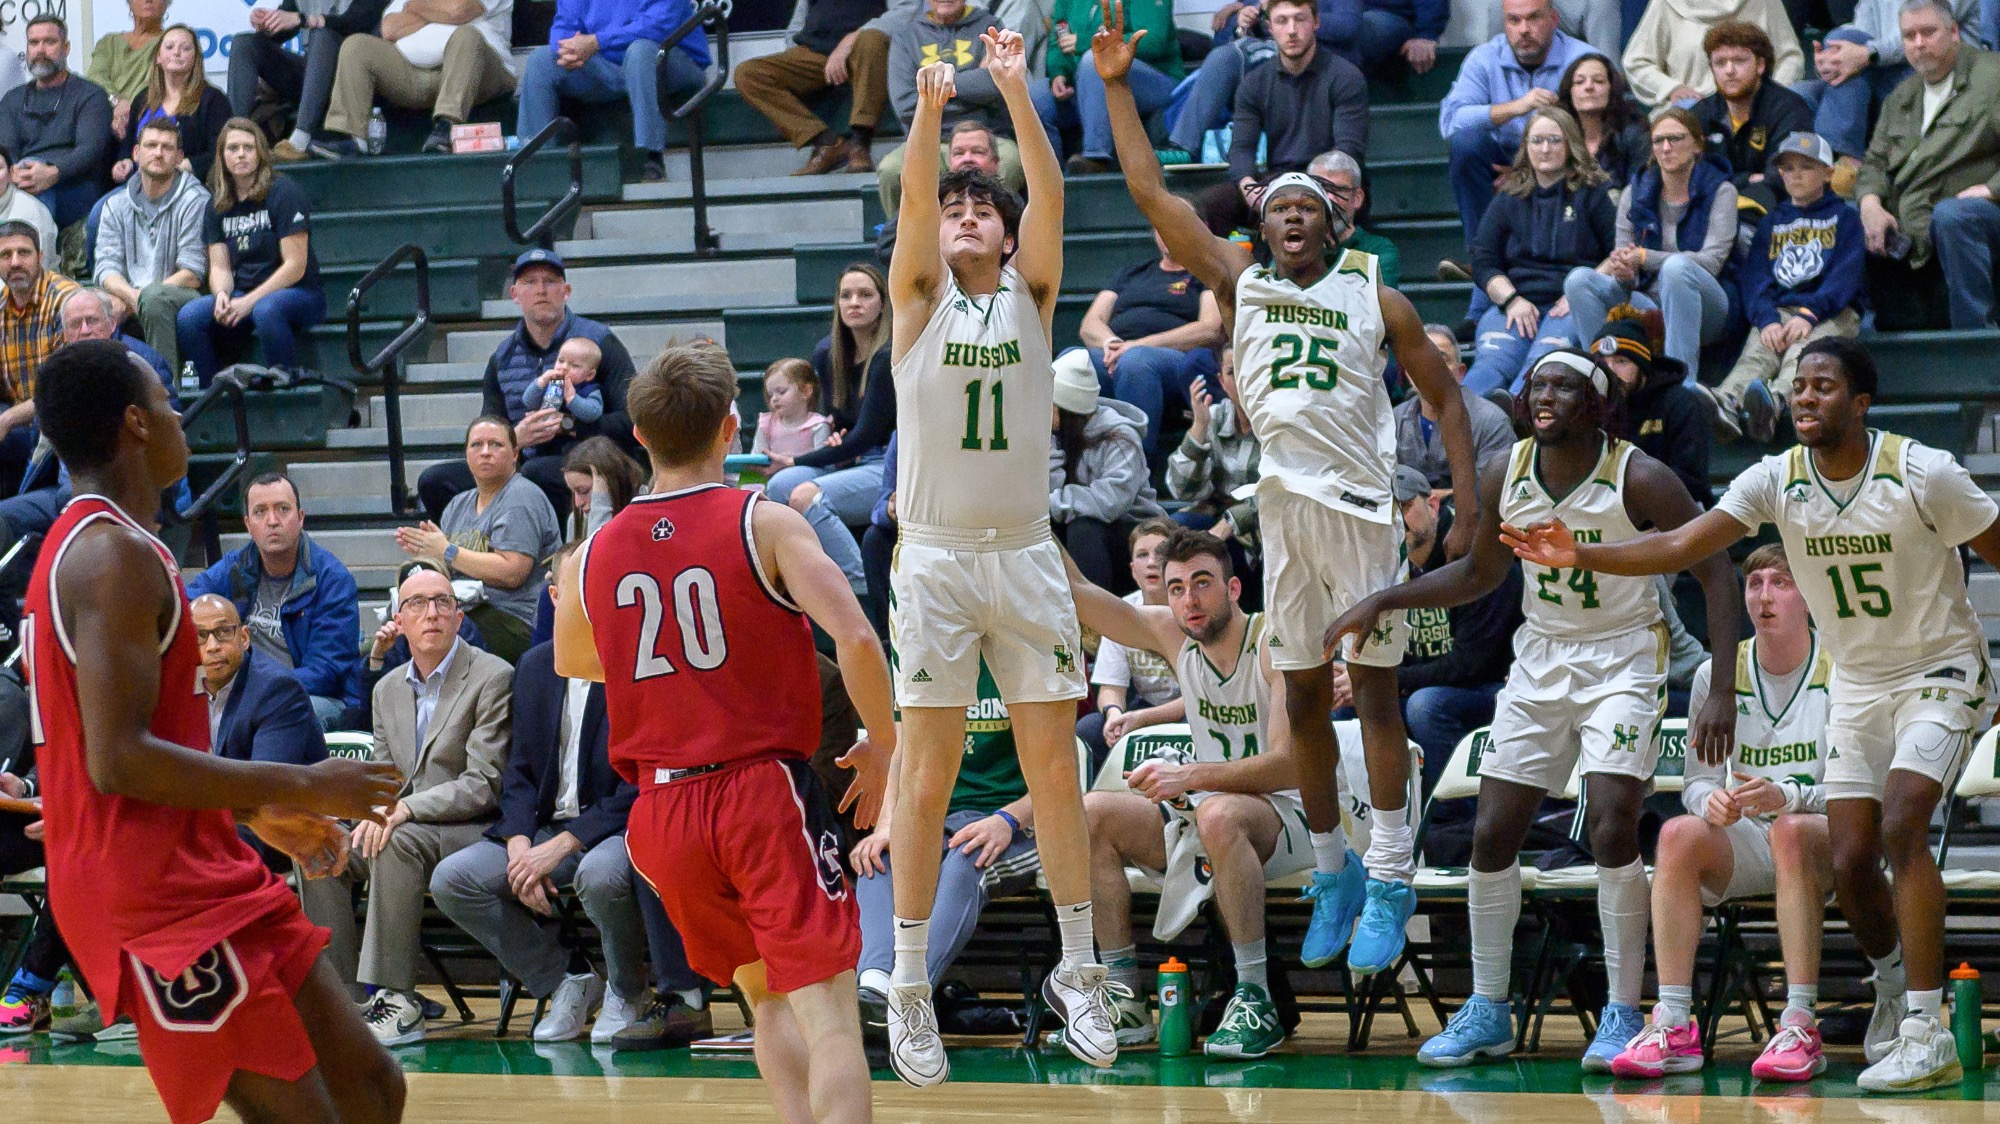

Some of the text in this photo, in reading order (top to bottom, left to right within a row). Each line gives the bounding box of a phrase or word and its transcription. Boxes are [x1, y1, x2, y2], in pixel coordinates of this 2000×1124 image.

[1265, 304, 1349, 331] HUSSON
[1271, 333, 1340, 392] 25
[960, 378, 1009, 452] 11
[1804, 532, 1894, 557] HUSSON
[1825, 562, 1893, 620] 15
[616, 565, 729, 682] 20
[966, 698, 1010, 719] SON
[1198, 698, 1258, 725] HUSSON
[1132, 741, 1195, 762] HUSSO
[1739, 740, 1818, 768] HUSSON
